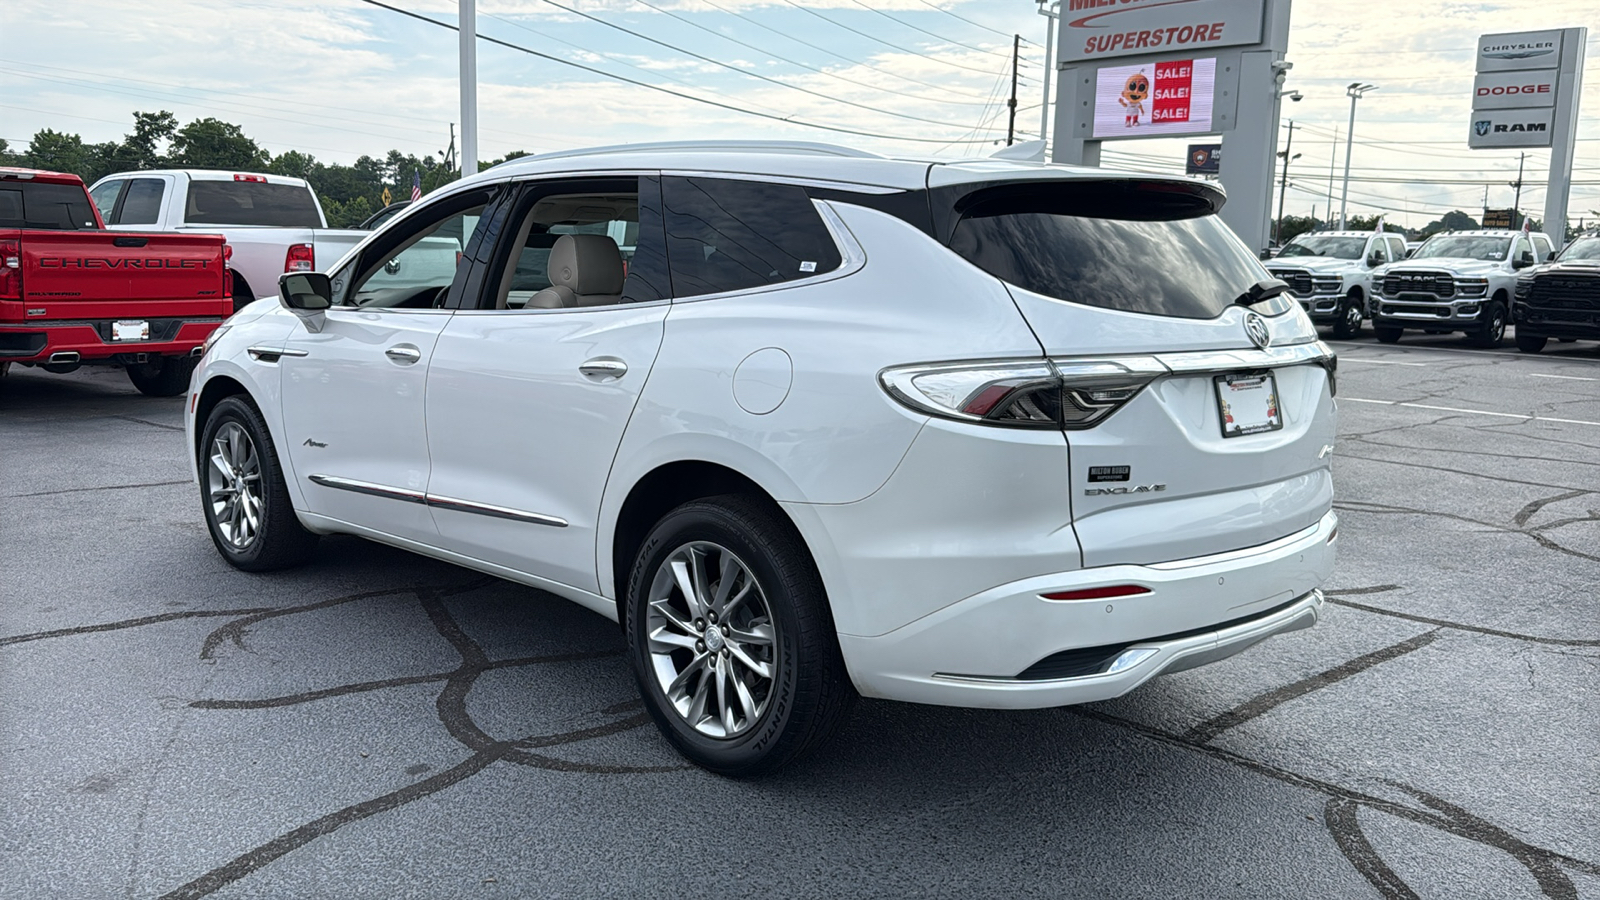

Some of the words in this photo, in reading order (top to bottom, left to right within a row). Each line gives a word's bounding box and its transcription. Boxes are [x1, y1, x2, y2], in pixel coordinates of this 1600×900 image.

[1084, 22, 1225, 54] SUPERSTORE
[1483, 42, 1553, 52] CHRYSLER
[1156, 67, 1190, 80] SALE!
[1154, 87, 1189, 100] SALE!
[1477, 84, 1551, 97] DODGE
[1153, 107, 1188, 120] SALE!
[1494, 123, 1546, 133] RAM
[40, 257, 212, 269] CHEVROLET
[1084, 484, 1167, 496] ENCLAVE
